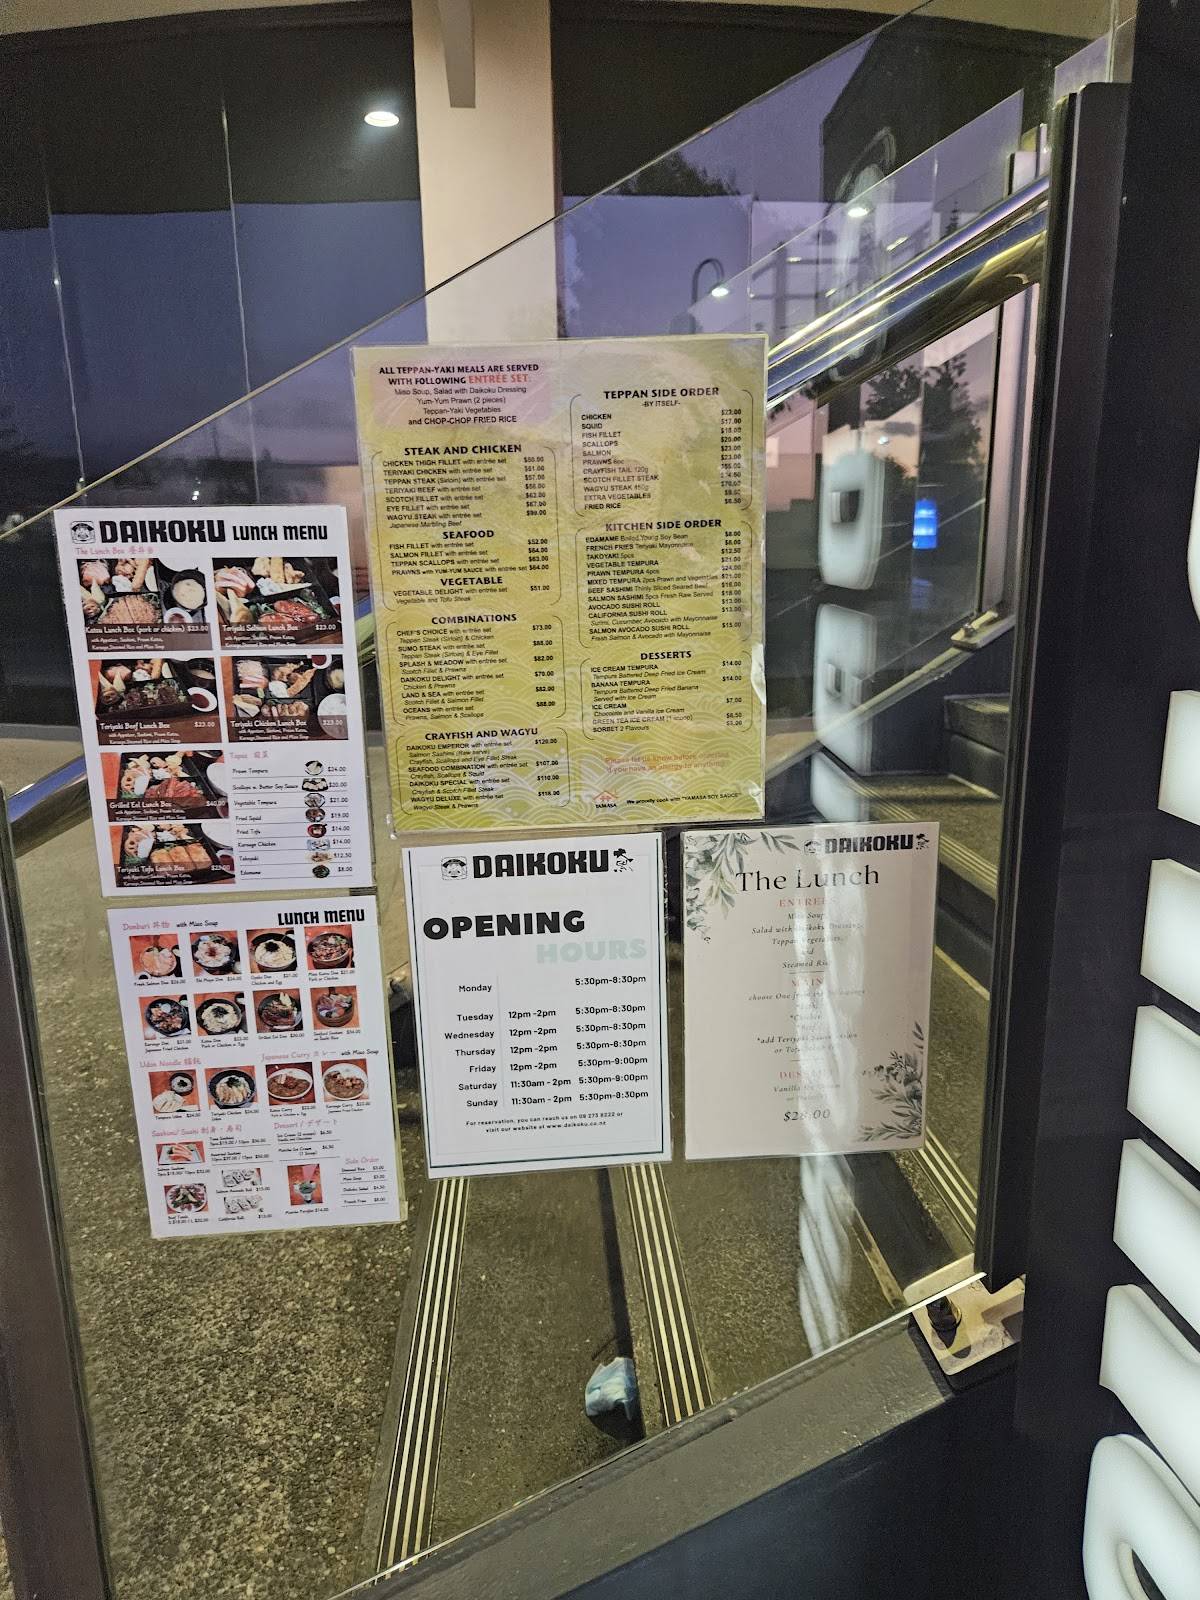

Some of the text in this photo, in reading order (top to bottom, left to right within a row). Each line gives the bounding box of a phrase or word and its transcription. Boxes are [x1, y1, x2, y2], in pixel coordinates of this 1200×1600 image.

[397, 366, 455, 374] TEPPAN-YAKI
[458, 365, 484, 373] MEALS
[498, 386, 527, 395] Dressing
[604, 388, 719, 399] TEPPAN SIDE ORDER
[465, 406, 501, 414] Vegetables
[424, 417, 471, 425] CHOP-CHOP
[405, 445, 521, 456] STEAK AND CHICKEN
[606, 519, 721, 531] KITCHEN SIDE ORDER
[99, 520, 328, 544] DAIKOKU LUNCH MENU
[443, 530, 494, 539] SEAFOOD
[441, 576, 502, 586] VEGETABLE
[432, 614, 517, 624] COMBINATIONS
[222, 625, 245, 633] Teriyaki
[641, 651, 692, 660] DESSERTS
[100, 723, 123, 731] Teriyaki
[125, 723, 138, 731] Beef
[230, 720, 253, 729] Teriyaki
[425, 728, 538, 740] CRAYFISH AND WAGYU
[826, 834, 913, 854] DAIKOKU
[473, 850, 609, 879] DAIKOKU
[736, 864, 879, 892] The Lunch
[278, 909, 365, 926] LUNCH MENU
[423, 910, 585, 940] OPENING
[752, 926, 772, 934] Salad
[536, 939, 647, 964] HOURS
[459, 976, 646, 993] Monday 5:30pm-8:30pm
[457, 1013, 494, 1023] Tuesday
[508, 1011, 531, 1019] 12pm
[575, 1005, 645, 1015] 5:30pm-8:30pm
[444, 1030, 494, 1040] Wednesday
[509, 1028, 531, 1037] 12pm
[576, 1022, 645, 1032] 5:30pm-8:30pm
[456, 1048, 495, 1057] Thursday
[510, 1045, 532, 1054] 12pm
[576, 1040, 646, 1050] 5:30pm-8:30pm
[469, 1064, 496, 1074] Friday
[510, 1063, 532, 1071] 12pm
[578, 1056, 648, 1067] 5:30pm-9:00pm
[459, 1073, 648, 1091] Saturday 11:30am 2pm 5:30pm-9:00pm
[467, 1091, 648, 1108] Sunday 11:30am 2pm 5:30pm-8:30pm
